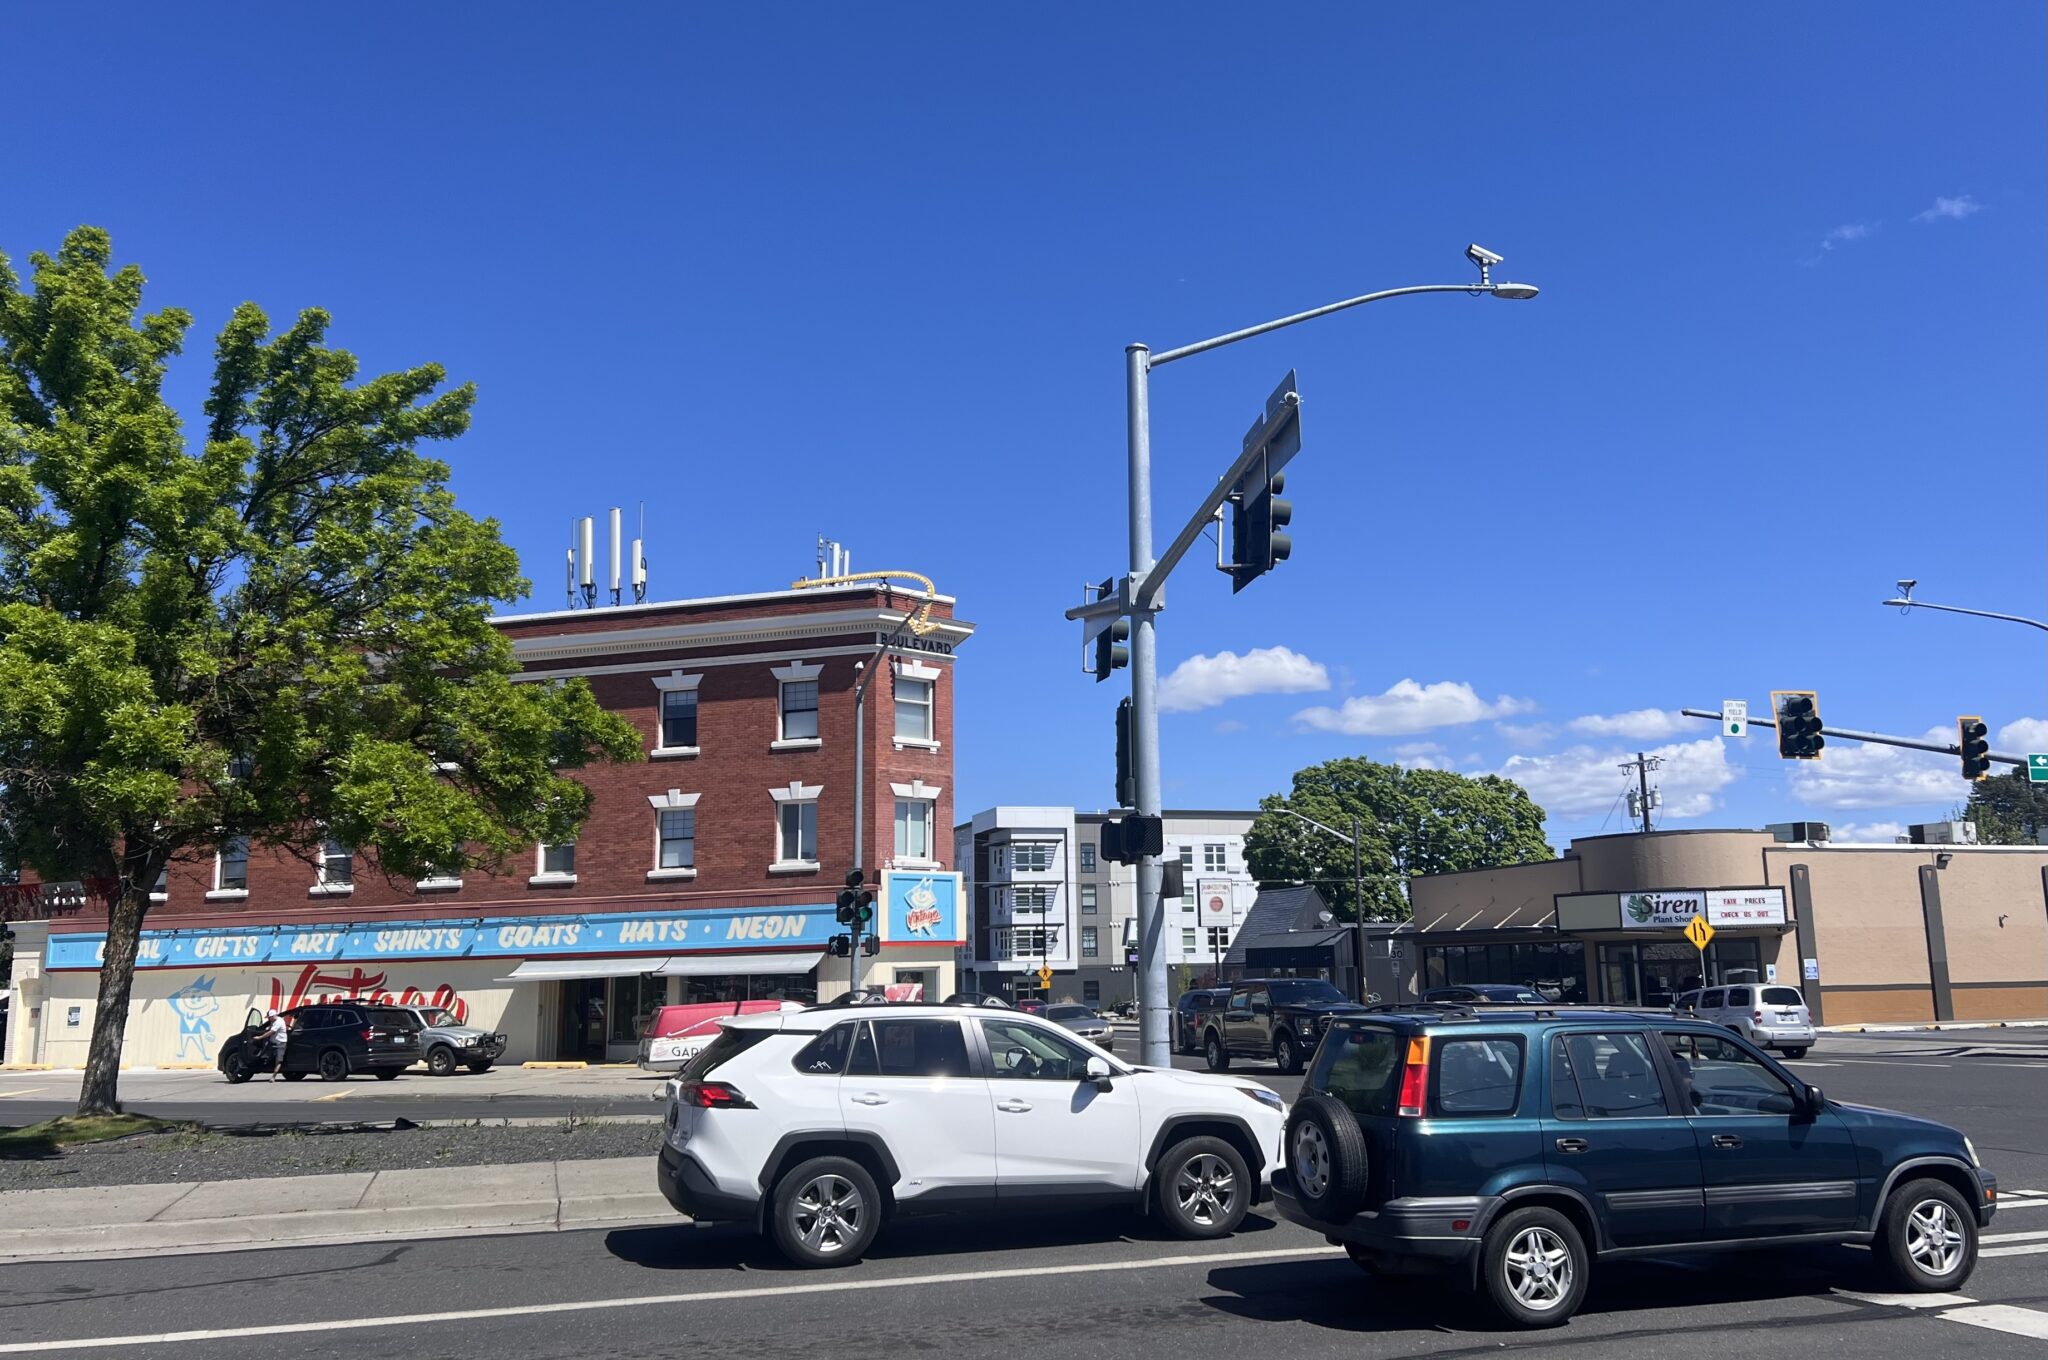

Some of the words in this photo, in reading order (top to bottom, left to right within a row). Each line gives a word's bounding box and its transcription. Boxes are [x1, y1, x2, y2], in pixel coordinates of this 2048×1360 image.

[881, 633, 952, 654] BOULEVARD
[1641, 894, 1699, 914] Siren
[1757, 910, 1769, 918] OUT
[194, 936, 259, 958] GIFTS
[291, 932, 339, 954] ART
[373, 928, 463, 952] SHIRTS
[498, 923, 580, 948] COATS
[618, 919, 689, 943] HATS
[726, 914, 806, 940] NEON
[1391, 950, 1403, 958] 30
